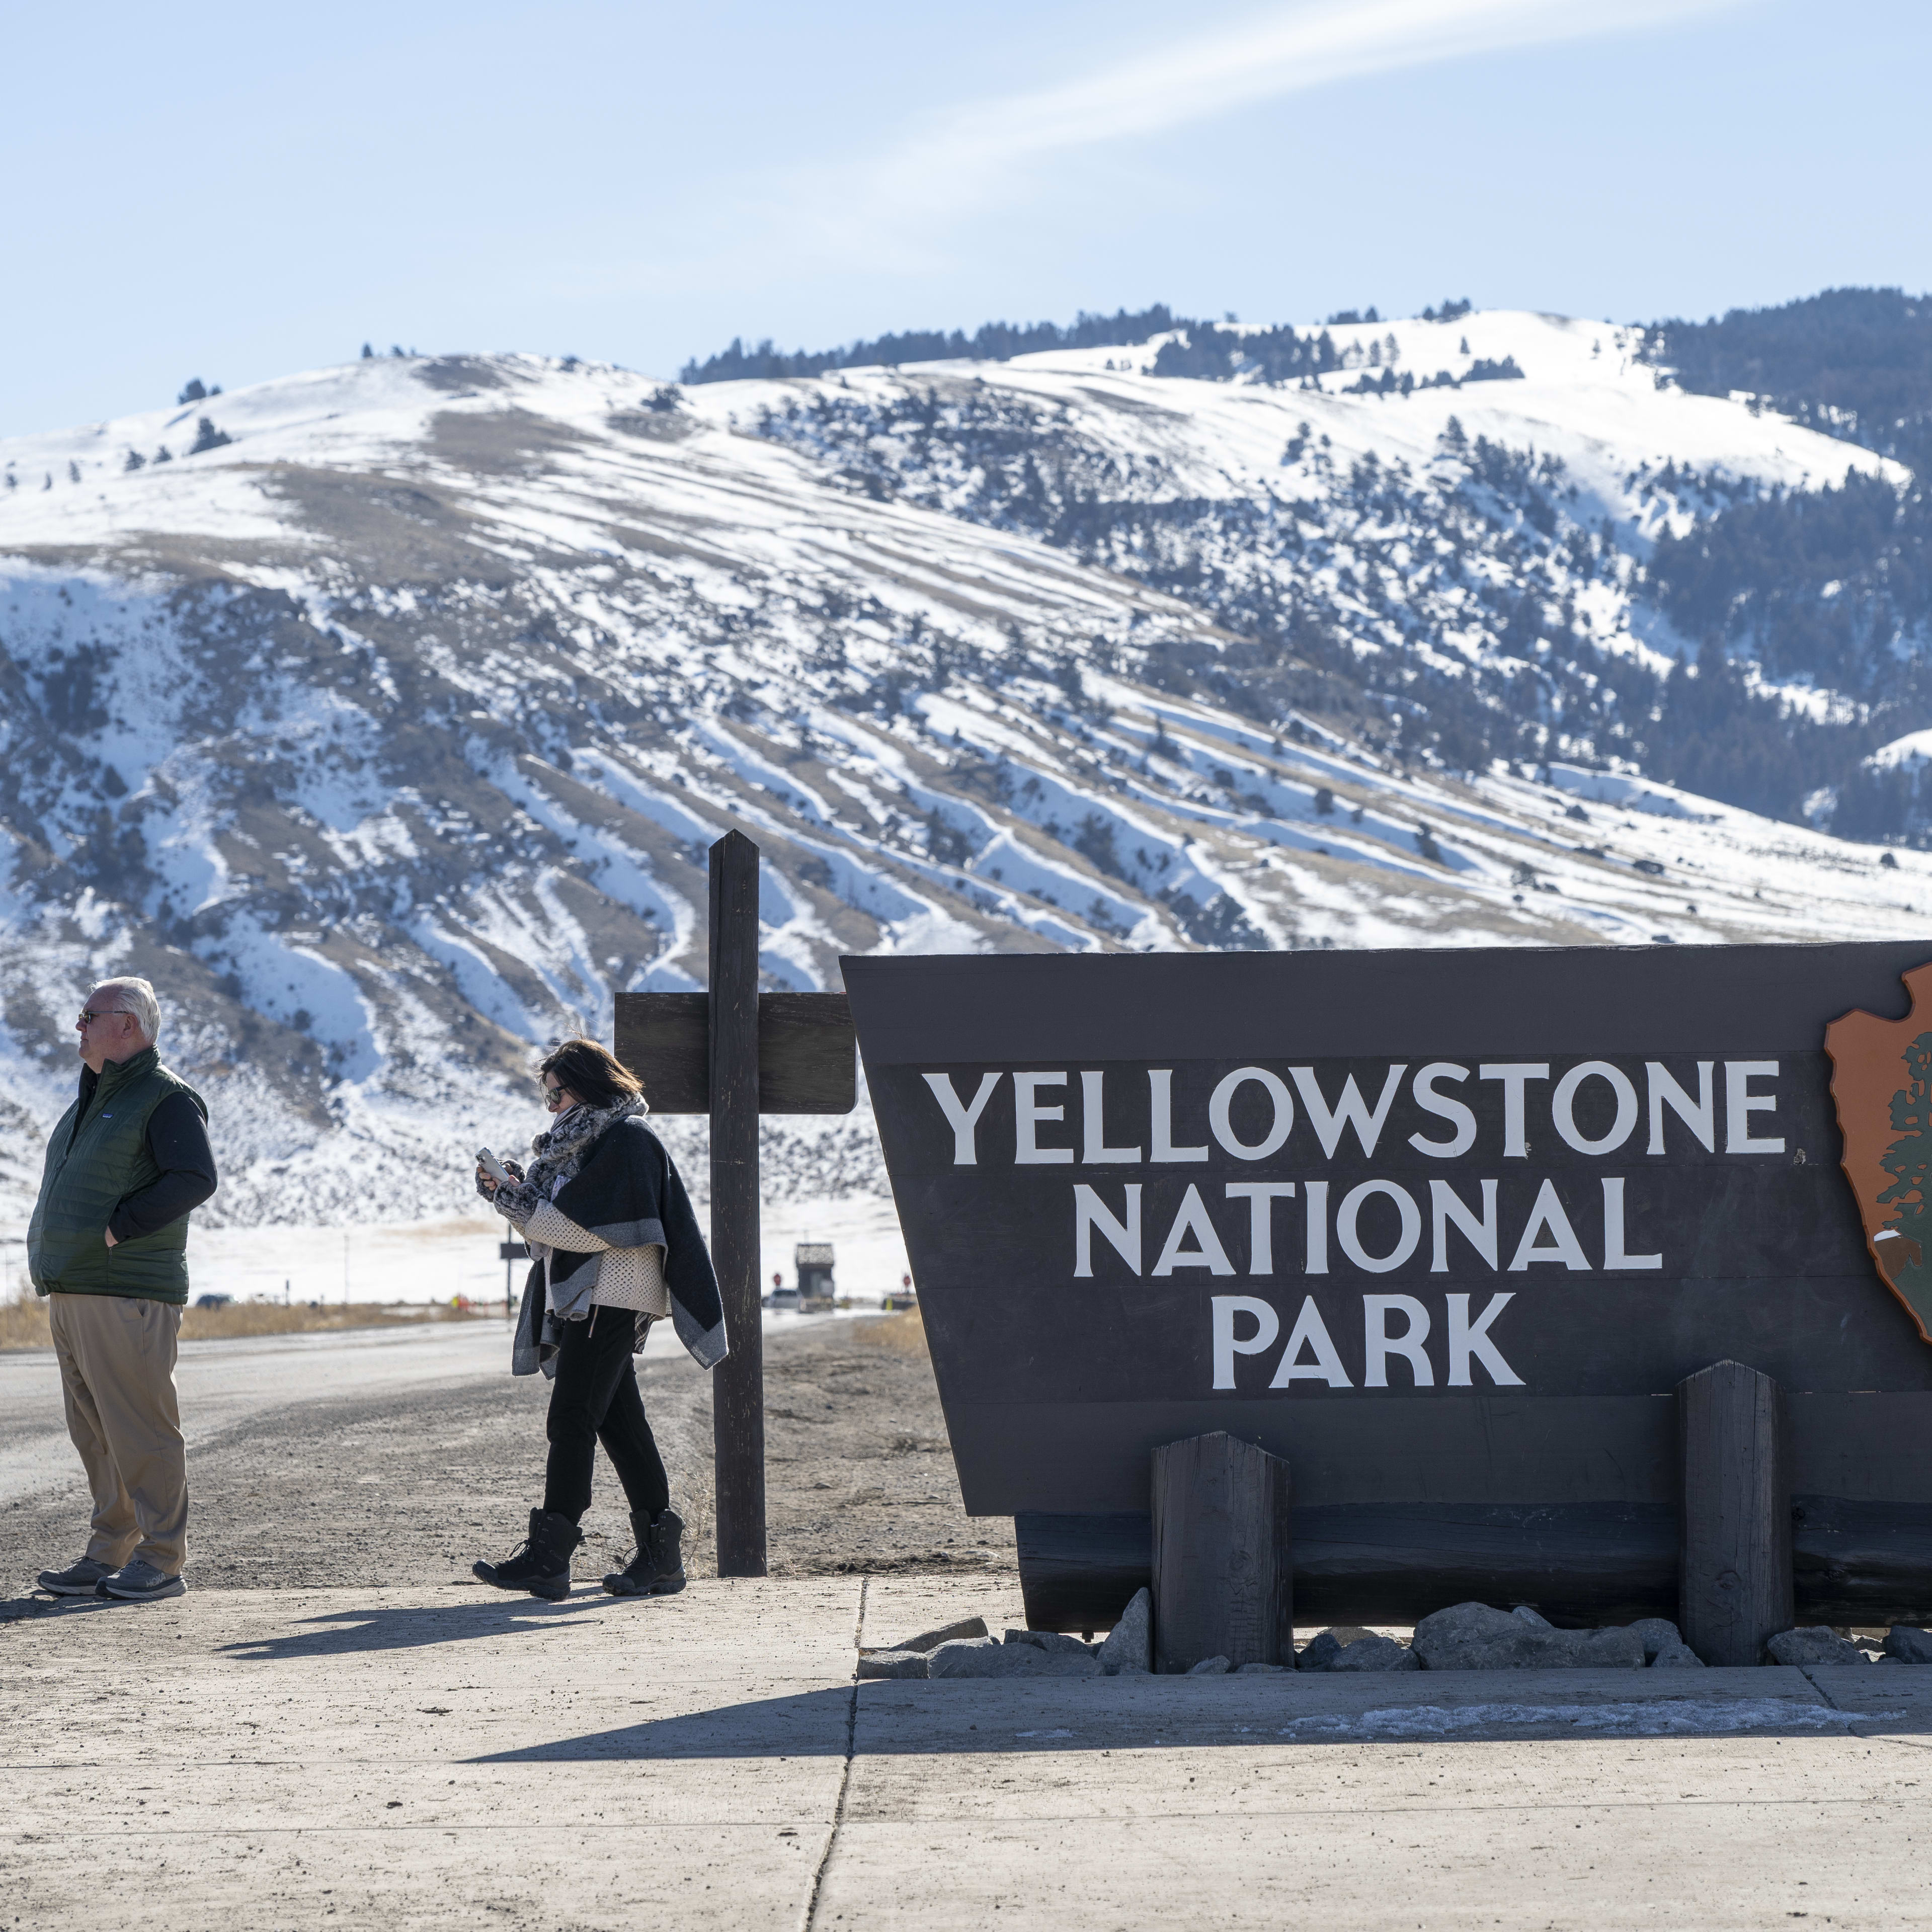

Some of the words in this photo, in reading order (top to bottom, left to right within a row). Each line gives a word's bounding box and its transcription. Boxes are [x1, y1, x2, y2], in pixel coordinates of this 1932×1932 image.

[921, 1060, 1786, 1165] YELLOWSTONE
[1072, 1177, 1663, 1278] NATIONAL
[1210, 1292, 1527, 1390] PARK
[145, 1572, 166, 1587] HOKA
